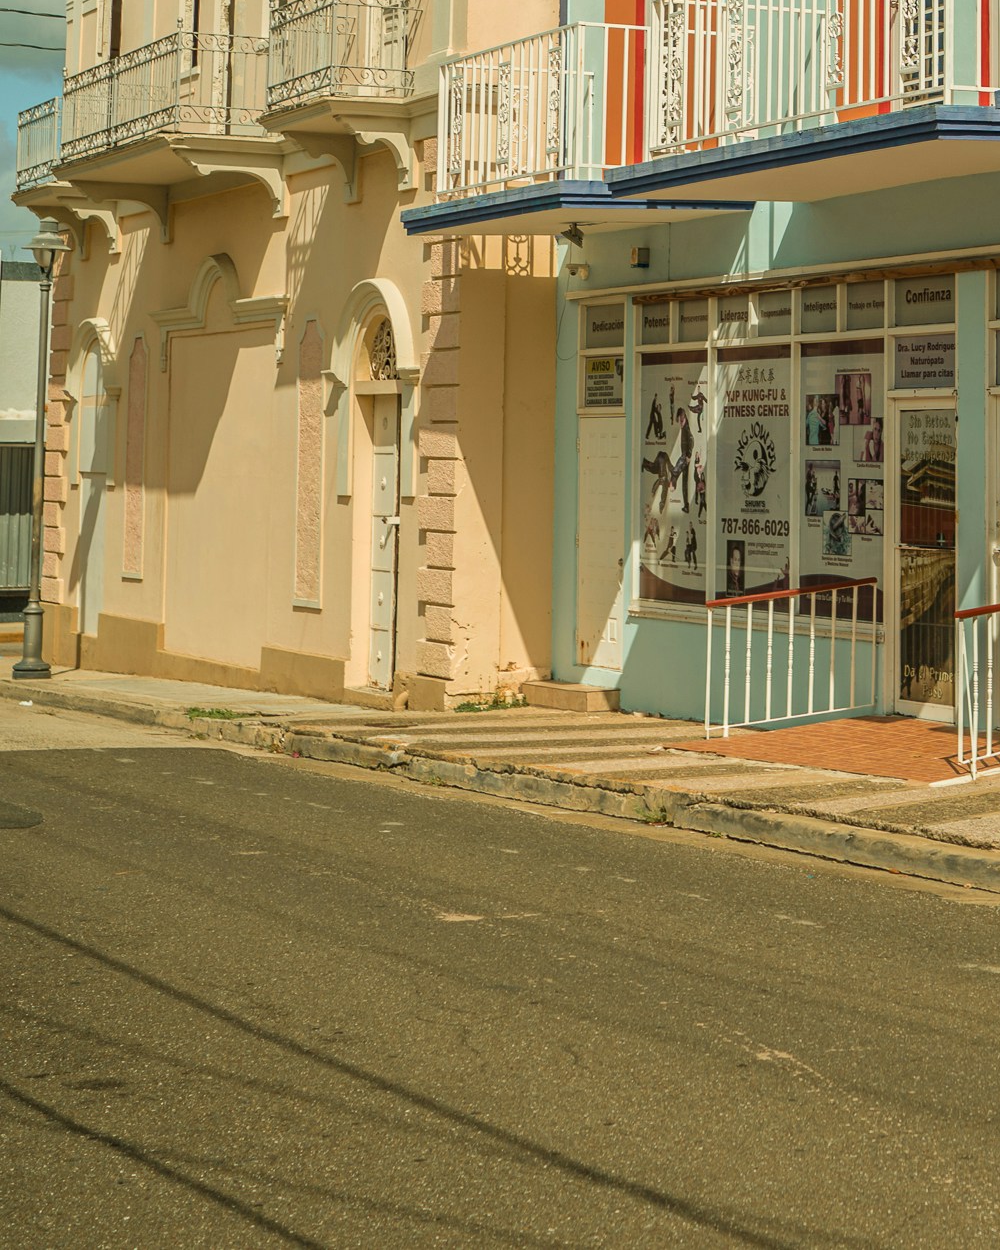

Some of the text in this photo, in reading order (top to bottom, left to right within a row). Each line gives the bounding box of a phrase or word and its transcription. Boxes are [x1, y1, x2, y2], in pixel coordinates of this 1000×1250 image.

[905, 288, 951, 304] Confianza
[804, 300, 837, 313] Inteligenci
[720, 310, 748, 322] Liderazg
[898, 342, 926, 354] Dra. Lucy
[592, 360, 611, 372] AVISO
[901, 368, 954, 380] Llamar para citas
[726, 388, 787, 403] YJP KUNG-FU &
[723, 404, 790, 418] FITNESS CENTER
[721, 517, 790, 537] 787-866-6029
